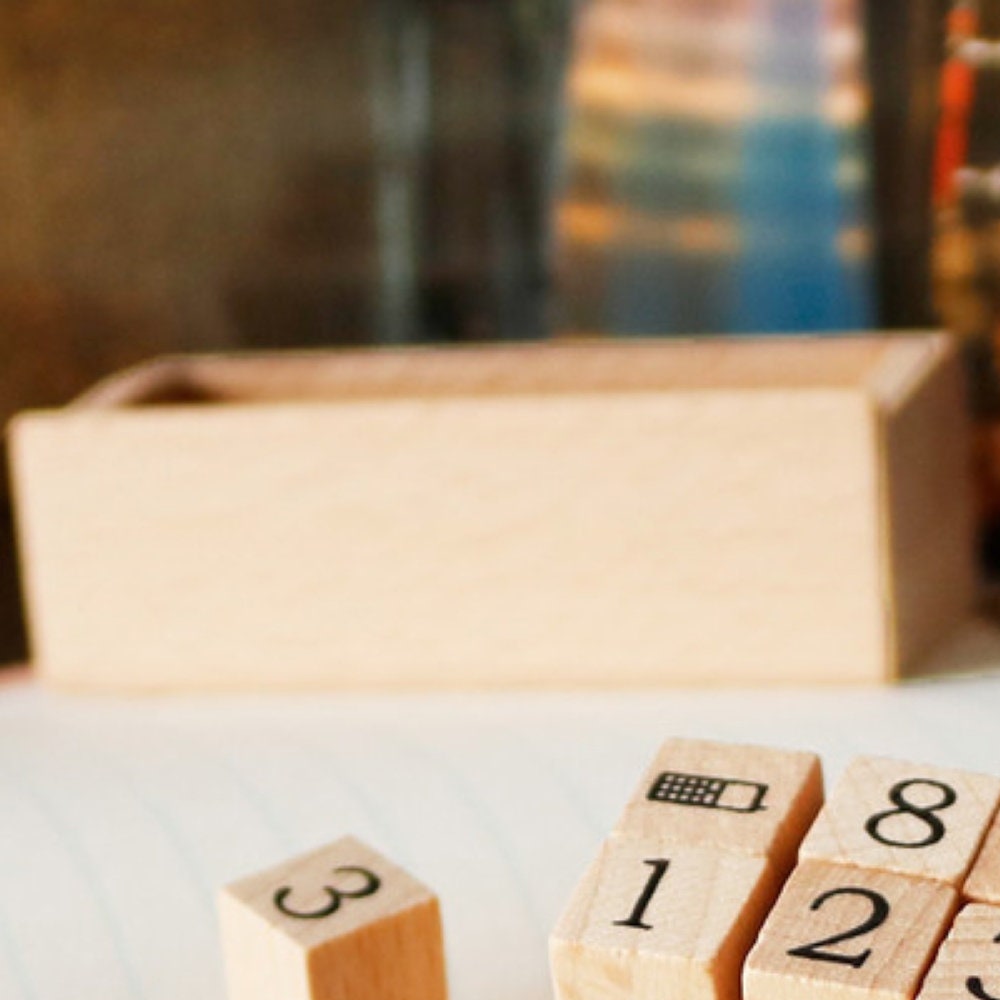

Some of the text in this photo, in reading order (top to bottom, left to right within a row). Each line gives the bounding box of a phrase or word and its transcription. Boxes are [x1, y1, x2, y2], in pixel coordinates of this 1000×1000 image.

[865, 778, 957, 849] 8
[273, 865, 381, 919] 3
[612, 858, 671, 930] 1
[786, 886, 890, 969] 2
